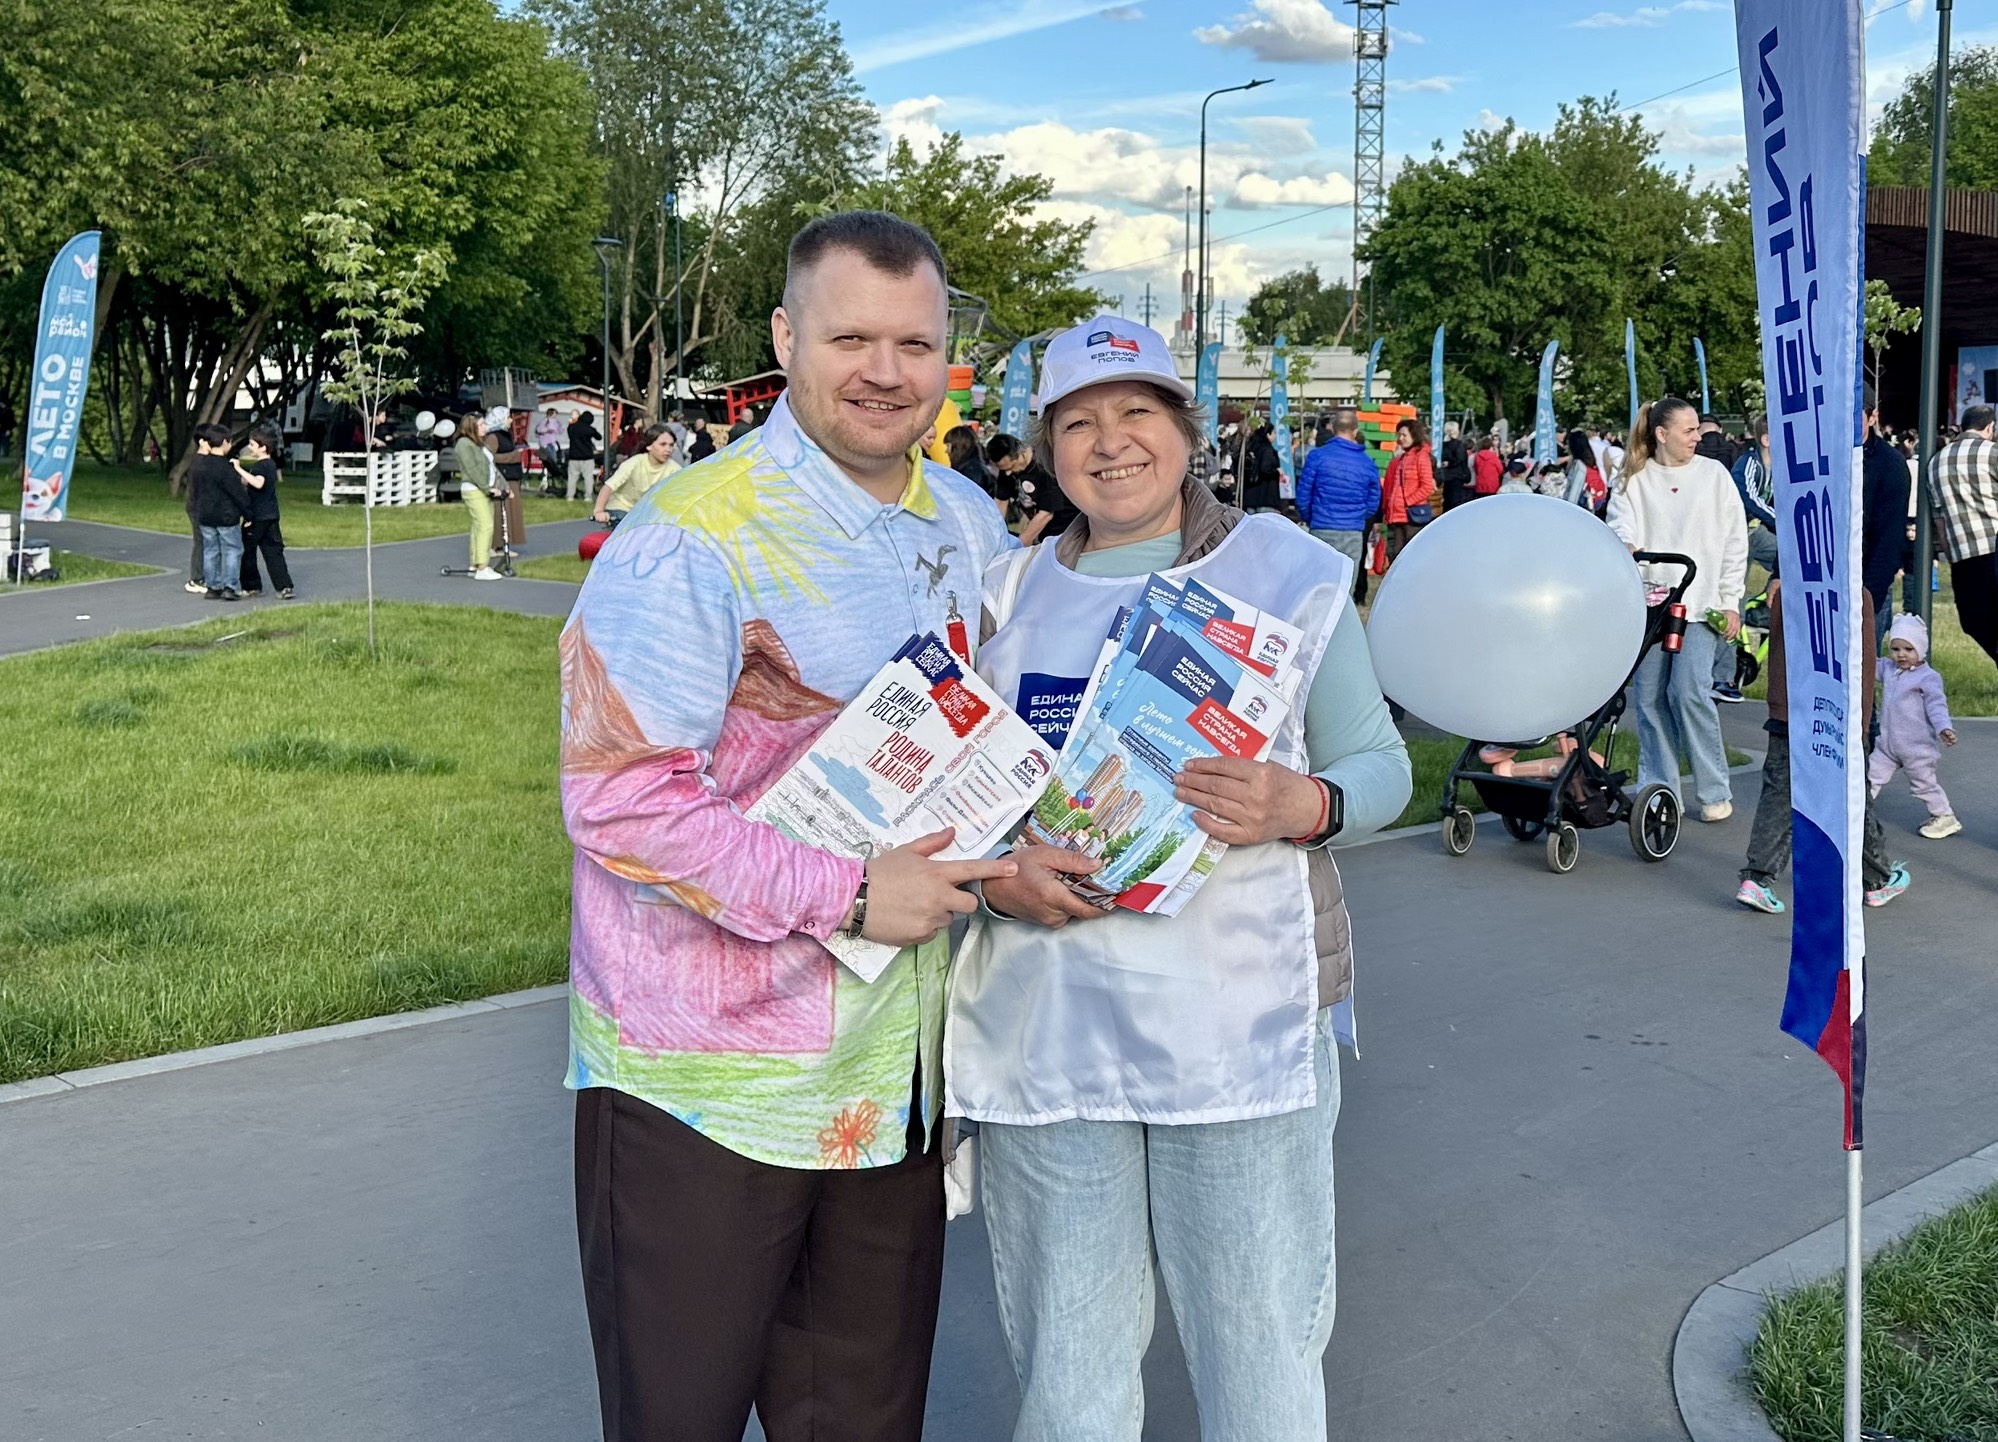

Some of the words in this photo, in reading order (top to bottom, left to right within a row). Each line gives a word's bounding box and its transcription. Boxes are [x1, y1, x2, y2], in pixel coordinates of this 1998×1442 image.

[1091, 350, 1140, 360] ЕВГЕНИЙ
[1097, 356, 1136, 364] ПОПОВ
[1757, 27, 1830, 674] ЕВГЕНИЙ
[30, 353, 67, 456] ЛЕТО
[56, 357, 84, 441] МОСКВЕ
[53, 443, 66, 460] В
[1181, 603, 1211, 620] СЕЙЧАС
[1184, 597, 1215, 615] РОССИЯ
[1187, 591, 1218, 609] ЕДИНАЯ
[1206, 633, 1245, 654] НАВСЕГДА
[1209, 627, 1239, 645] СТРАНА
[1212, 621, 1247, 641] ВЕЛИКАЯ
[915, 655, 940, 678] СЕЙЧАС
[921, 649, 946, 672] РОССИЯ
[928, 642, 951, 667] ЕДИНАЯ
[1171, 669, 1206, 698] СЕЙЧАС
[1175, 662, 1212, 693] РОССИЯ
[1180, 656, 1217, 687] ЕДИНАЯ
[879, 681, 933, 718] ЕДИНАЯ
[949, 683, 978, 711] ВЕЛИКАЯ
[1031, 693, 1083, 706] ЕДИНА
[865, 697, 917, 733] РОССИЯ
[937, 698, 969, 726] НАВСЕГДА
[1029, 708, 1076, 720] РОСС
[1138, 701, 1174, 725] Лето
[1207, 706, 1248, 740] ВЕЛИКАЯ
[1030, 721, 1070, 734] СЕЙЧ
[1140, 722, 1185, 749] лучшем
[1197, 720, 1242, 757] НАВСЕГДА
[1202, 713, 1237, 742] СТРАНА
[881, 731, 935, 775] РОДИНА
[865, 748, 923, 794] ТАЛАНТОВ
[893, 775, 946, 827] РАСКРАСЬ
[944, 743, 975, 774] СВОЙ
[973, 708, 1009, 744] ГОРОД
